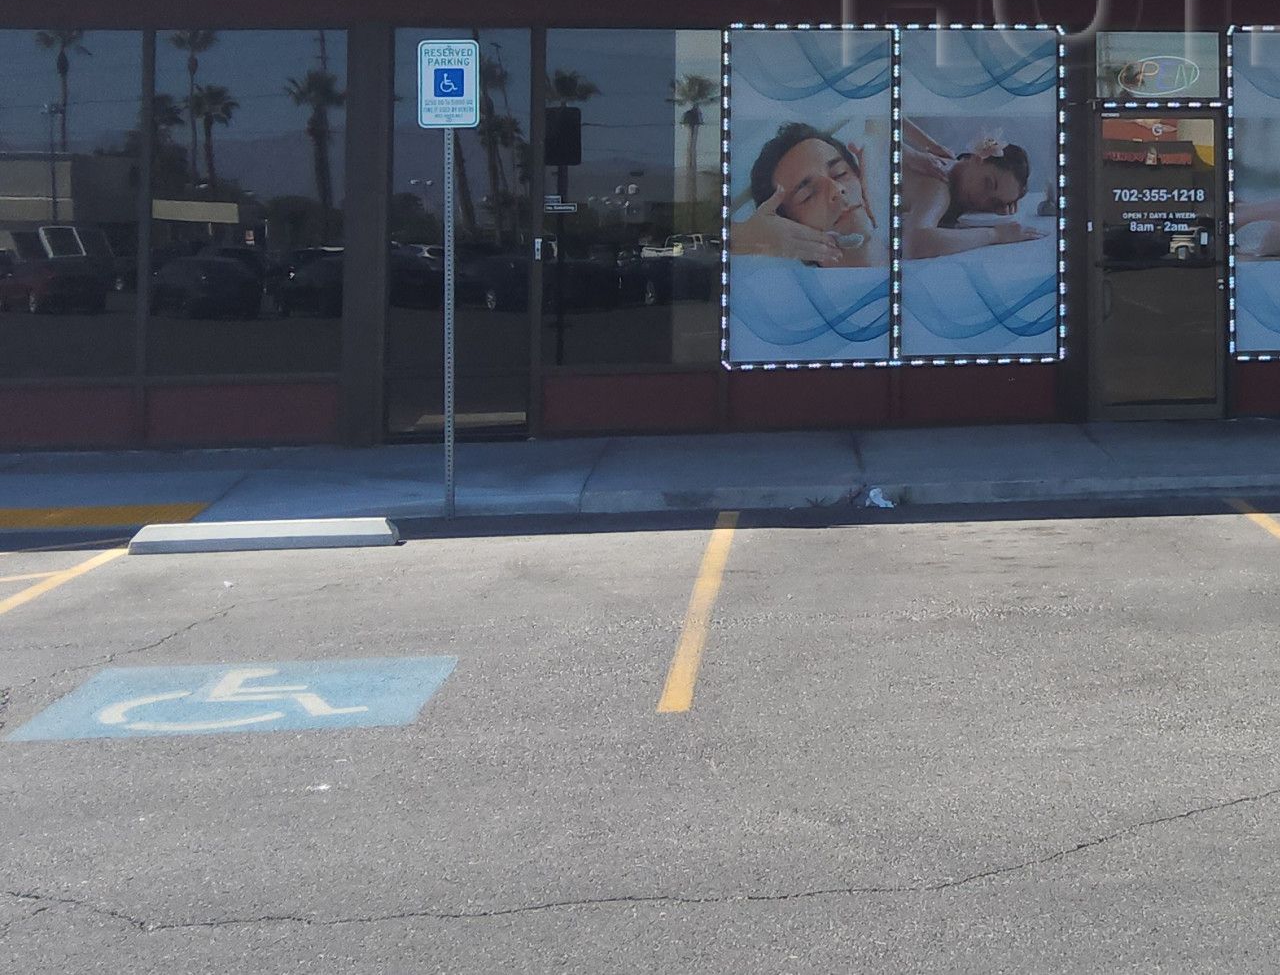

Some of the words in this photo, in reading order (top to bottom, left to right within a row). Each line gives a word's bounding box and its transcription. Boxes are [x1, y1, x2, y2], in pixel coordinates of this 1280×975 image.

[424, 48, 473, 57] RESERVED
[427, 57, 470, 66] PARKING
[1121, 61, 1197, 88] OPEN
[1113, 189, 1205, 202] 702-355-1218
[1130, 221, 1154, 232] 8am
[1163, 221, 1188, 232] 2am
